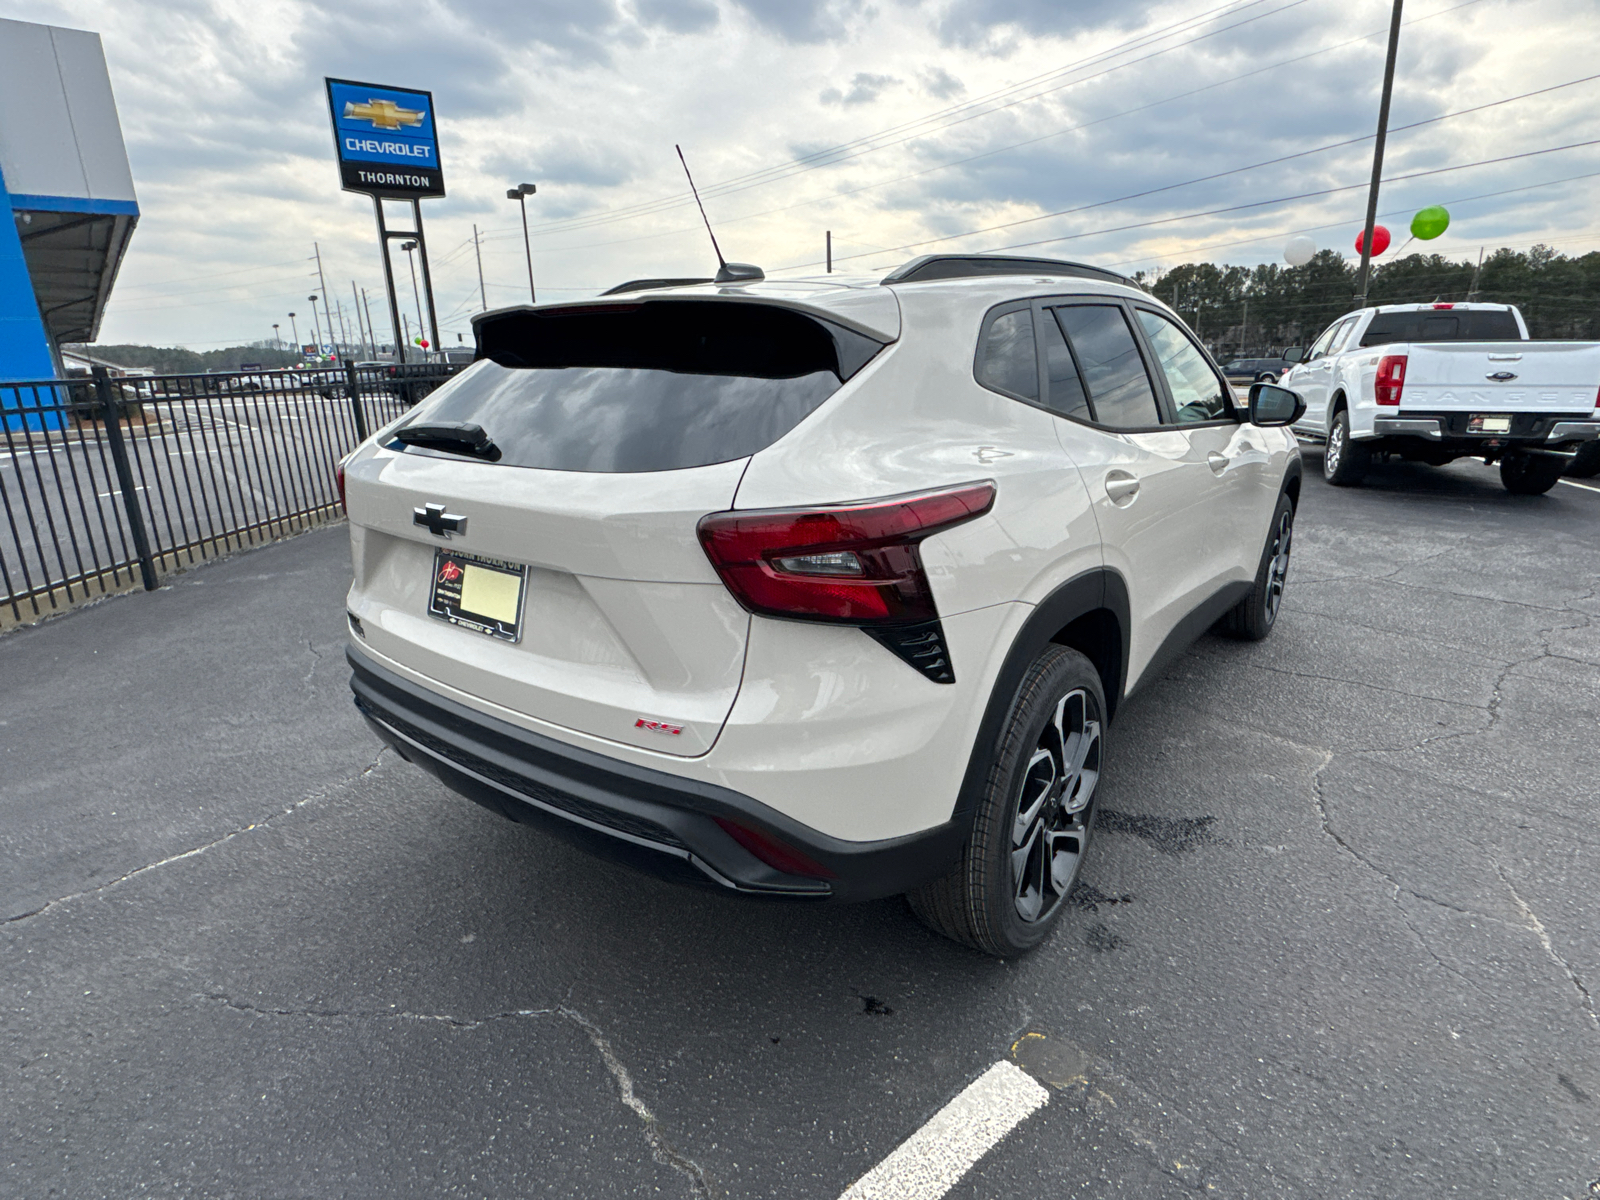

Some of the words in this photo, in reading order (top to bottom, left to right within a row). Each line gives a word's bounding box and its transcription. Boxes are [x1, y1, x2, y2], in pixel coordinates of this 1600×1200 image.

[345, 138, 430, 157] CHEVROLET
[358, 170, 430, 187] THORNTON
[1406, 391, 1591, 403] RANGER
[634, 718, 684, 735] RS
